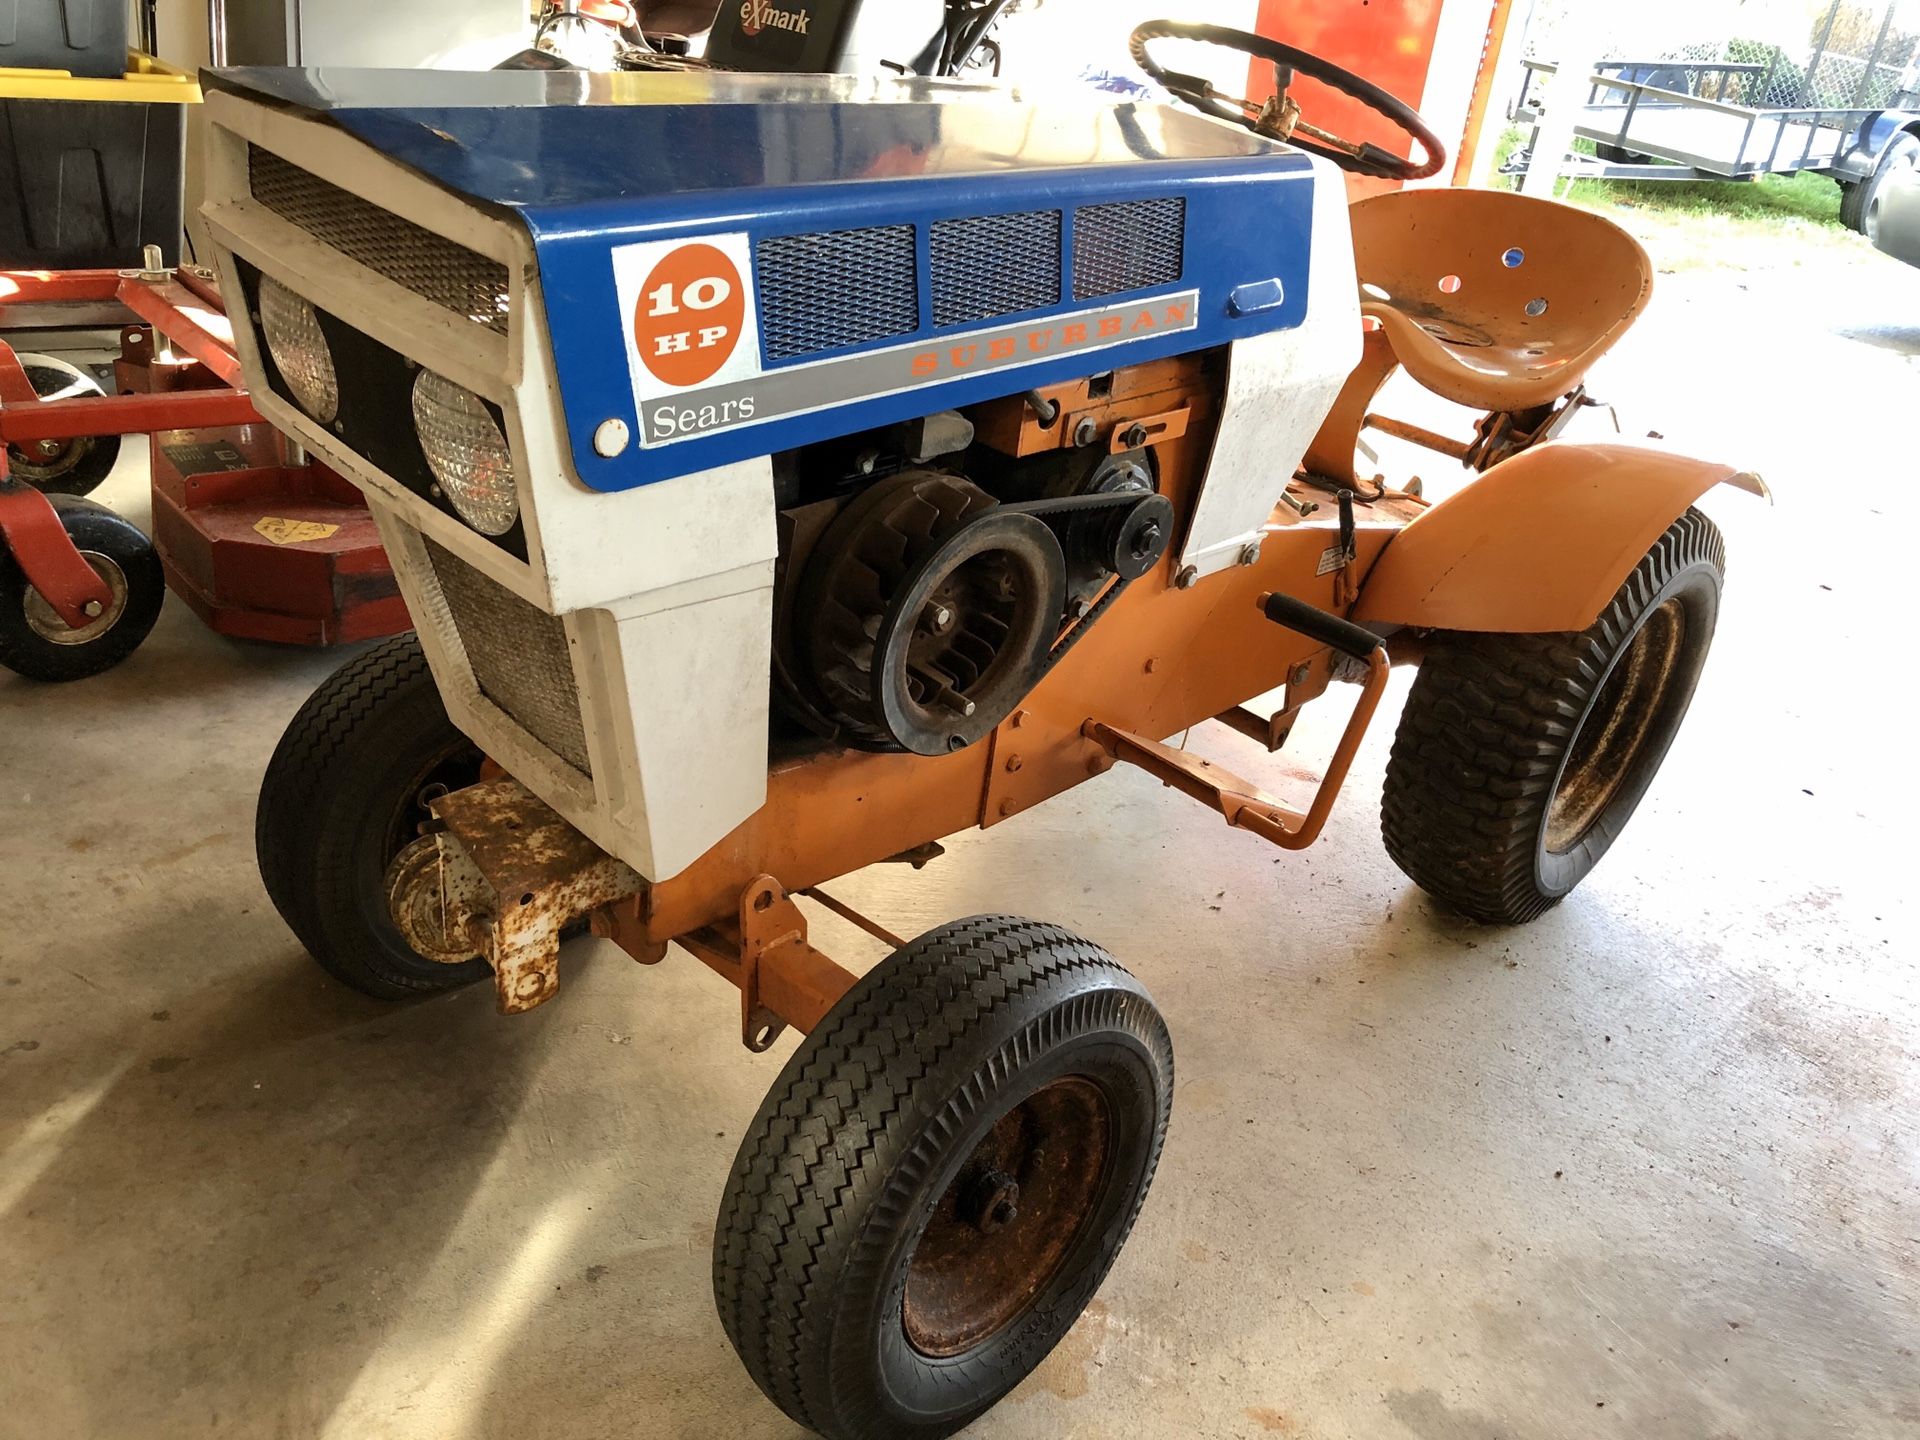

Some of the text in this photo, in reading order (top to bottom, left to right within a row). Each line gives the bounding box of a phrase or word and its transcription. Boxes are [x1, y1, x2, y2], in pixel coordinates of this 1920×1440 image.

[740, 0, 810, 34] eXmark
[648, 276, 731, 317] 10
[654, 325, 729, 356] HP
[911, 302, 1189, 376] SUBURBAN
[653, 395, 755, 438] Sears
